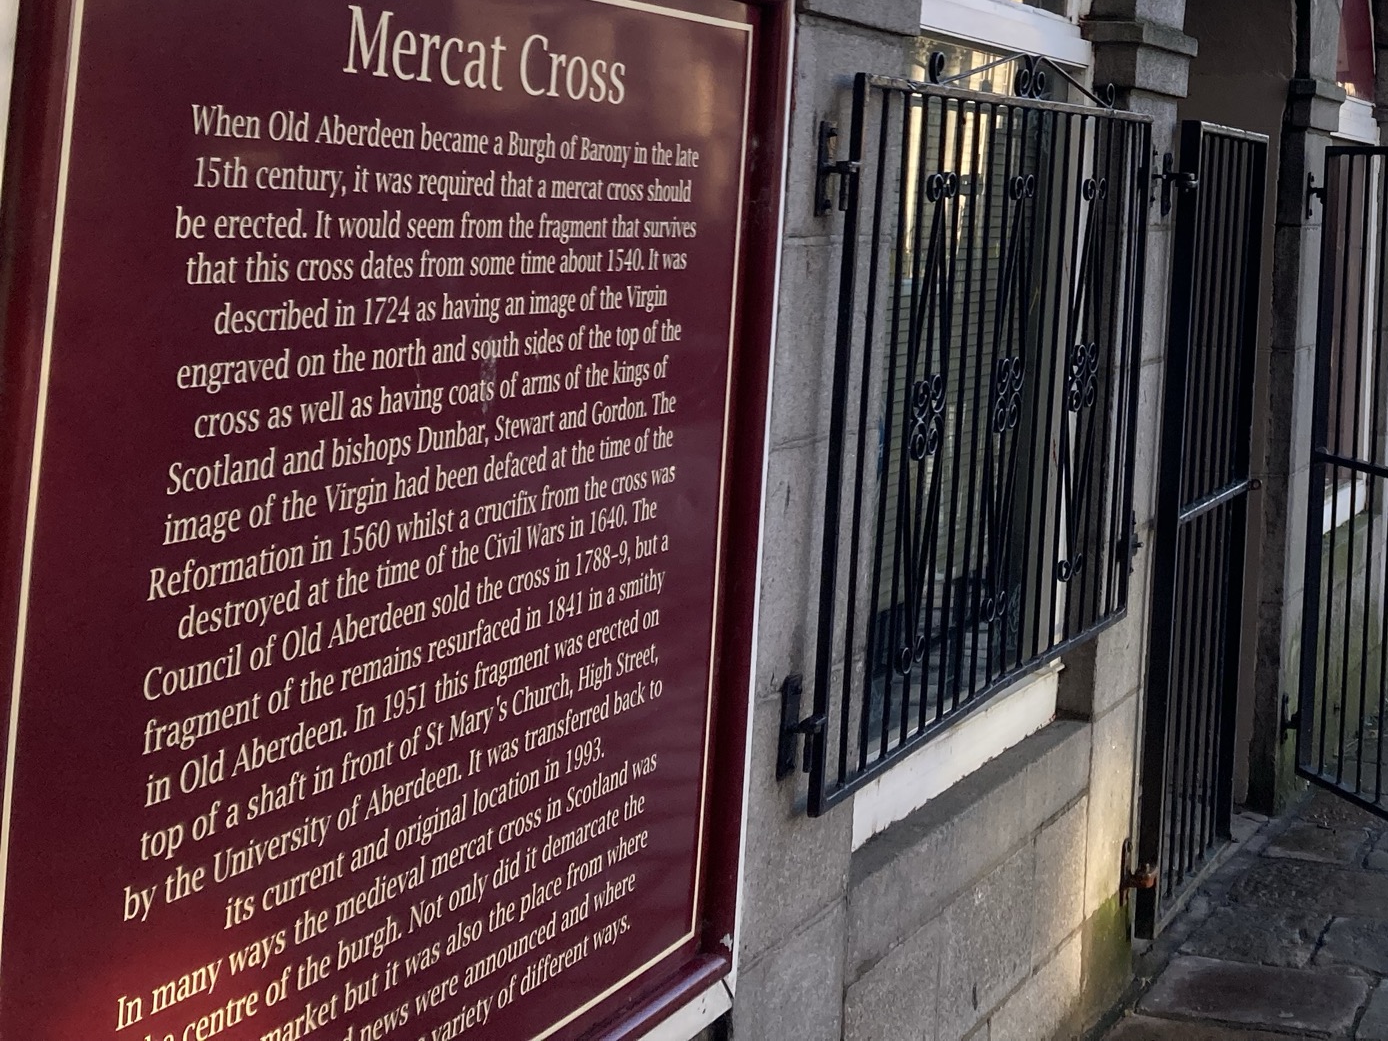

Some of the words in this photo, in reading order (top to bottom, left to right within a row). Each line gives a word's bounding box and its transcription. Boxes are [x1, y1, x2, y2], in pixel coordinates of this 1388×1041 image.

[341, 3, 507, 92] Mercat
[519, 33, 626, 105] Cross
[190, 103, 261, 140] When
[267, 109, 310, 143] Old
[314, 113, 415, 150] Aberdeen
[419, 121, 490, 155] became
[492, 135, 504, 156] a
[506, 130, 556, 165] Burgh
[559, 133, 579, 160] of
[578, 136, 632, 169] Barony
[632, 140, 648, 165] in
[650, 141, 673, 167] the
[674, 142, 700, 168] late
[193, 155, 249, 189] 15th
[255, 164, 347, 199] century,
[351, 164, 371, 193] it
[374, 171, 413, 195] was
[416, 168, 496, 202] required
[499, 169, 534, 199] that
[536, 178, 547, 199] a
[549, 178, 605, 201] mercat
[605, 181, 645, 202] cross
[646, 177, 692, 203] should
[174, 204, 207, 240] be
[213, 207, 308, 239] erected.
[313, 209, 333, 239] It
[337, 208, 402, 239] would
[405, 217, 455, 239] seem
[458, 210, 504, 239] from
[507, 211, 535, 239] the
[537, 211, 609, 245] fragment
[610, 213, 641, 239] that
[642, 215, 697, 239] survives
[185, 251, 239, 285] that
[245, 250, 290, 284] this
[295, 257, 355, 282] cross
[359, 249, 414, 280] dates
[418, 248, 465, 278] from
[468, 254, 516, 277] some
[519, 249, 556, 275] time
[558, 247, 604, 274] about
[605, 246, 645, 273] 1540.
[646, 247, 660, 271] It
[661, 251, 688, 270] was
[175, 347, 290, 394] engraved
[296, 353, 327, 378] on
[332, 342, 367, 375] the
[370, 337, 427, 371] north
[430, 333, 467, 365] and
[470, 330, 520, 364] south
[522, 327, 565, 359] sides
[567, 324, 587, 352] of
[587, 323, 612, 350] the
[614, 325, 640, 351] top
[641, 318, 660, 345] of
[660, 317, 682, 343] the
[213, 296, 330, 336] described
[333, 298, 357, 328] in
[362, 294, 411, 326] 1724
[414, 300, 437, 323] as
[440, 292, 502, 324] having
[503, 295, 526, 317] an
[527, 289, 577, 319] image
[578, 284, 598, 312] of
[598, 284, 623, 310] the
[625, 283, 668, 313] Virgin
[193, 408, 261, 439] cross
[266, 404, 293, 430] as
[298, 389, 345, 425] well
[349, 395, 373, 419] as
[377, 382, 445, 416] having
[447, 378, 495, 406] coats
[498, 370, 520, 400] of
[520, 372, 561, 397] arms
[563, 362, 583, 391] of
[584, 361, 610, 389] the
[610, 359, 650, 388] kings
[652, 353, 670, 380] of
[161, 507, 242, 546] image
[247, 492, 277, 529] of
[281, 488, 318, 523] the
[324, 477, 388, 515] Virgin
[392, 465, 431, 501] had
[434, 463, 479, 493] been
[482, 444, 548, 483] defaced
[550, 445, 568, 470] at
[570, 438, 596, 466] the
[598, 435, 632, 461] time
[633, 426, 651, 454] of
[652, 425, 674, 450] the
[177, 578, 301, 640] destroyed
[306, 576, 331, 608] at
[335, 566, 370, 600] the
[375, 558, 420, 589] time
[424, 543, 448, 576] of
[450, 539, 480, 570] the
[483, 525, 522, 561] Civil
[525, 521, 566, 550] Wars
[567, 514, 585, 540] in
[588, 502, 628, 535] 1640.
[631, 496, 658, 524] The
[141, 691, 262, 756] fragment
[266, 676, 295, 715] of
[298, 669, 335, 705] the
[339, 645, 423, 692] remains
[426, 606, 522, 663] resurfaced
[524, 605, 542, 632] in
[546, 589, 583, 625] 1841
[586, 586, 604, 612] in
[605, 585, 615, 606] a
[618, 567, 666, 602] smithy
[143, 772, 171, 809] in
[179, 747, 226, 794] Old
[229, 716, 348, 778] Aberdeen.
[352, 702, 376, 734] In
[381, 681, 427, 723] 1951
[434, 669, 469, 704] this
[472, 642, 551, 691] fragment
[553, 633, 584, 661] was
[586, 607, 640, 650] erected
[641, 608, 660, 630] on
[122, 884, 158, 923] by
[164, 864, 206, 904] the
[213, 813, 333, 883] University
[336, 793, 362, 832] of
[363, 762, 463, 821] Aberdeen.
[466, 747, 483, 777] It
[486, 736, 519, 767] was
[523, 692, 610, 753] transferred
[612, 680, 646, 716] back
[648, 678, 663, 700] to
[114, 994, 144, 1032] In
[149, 957, 224, 1016] many
[227, 928, 287, 976] ways
[293, 908, 329, 945] the
[333, 854, 426, 927] medieval
[429, 826, 495, 880] mercat
[497, 806, 542, 845] cross
[544, 796, 562, 823] in
[564, 759, 629, 813] Scotland
[631, 752, 658, 780] was
